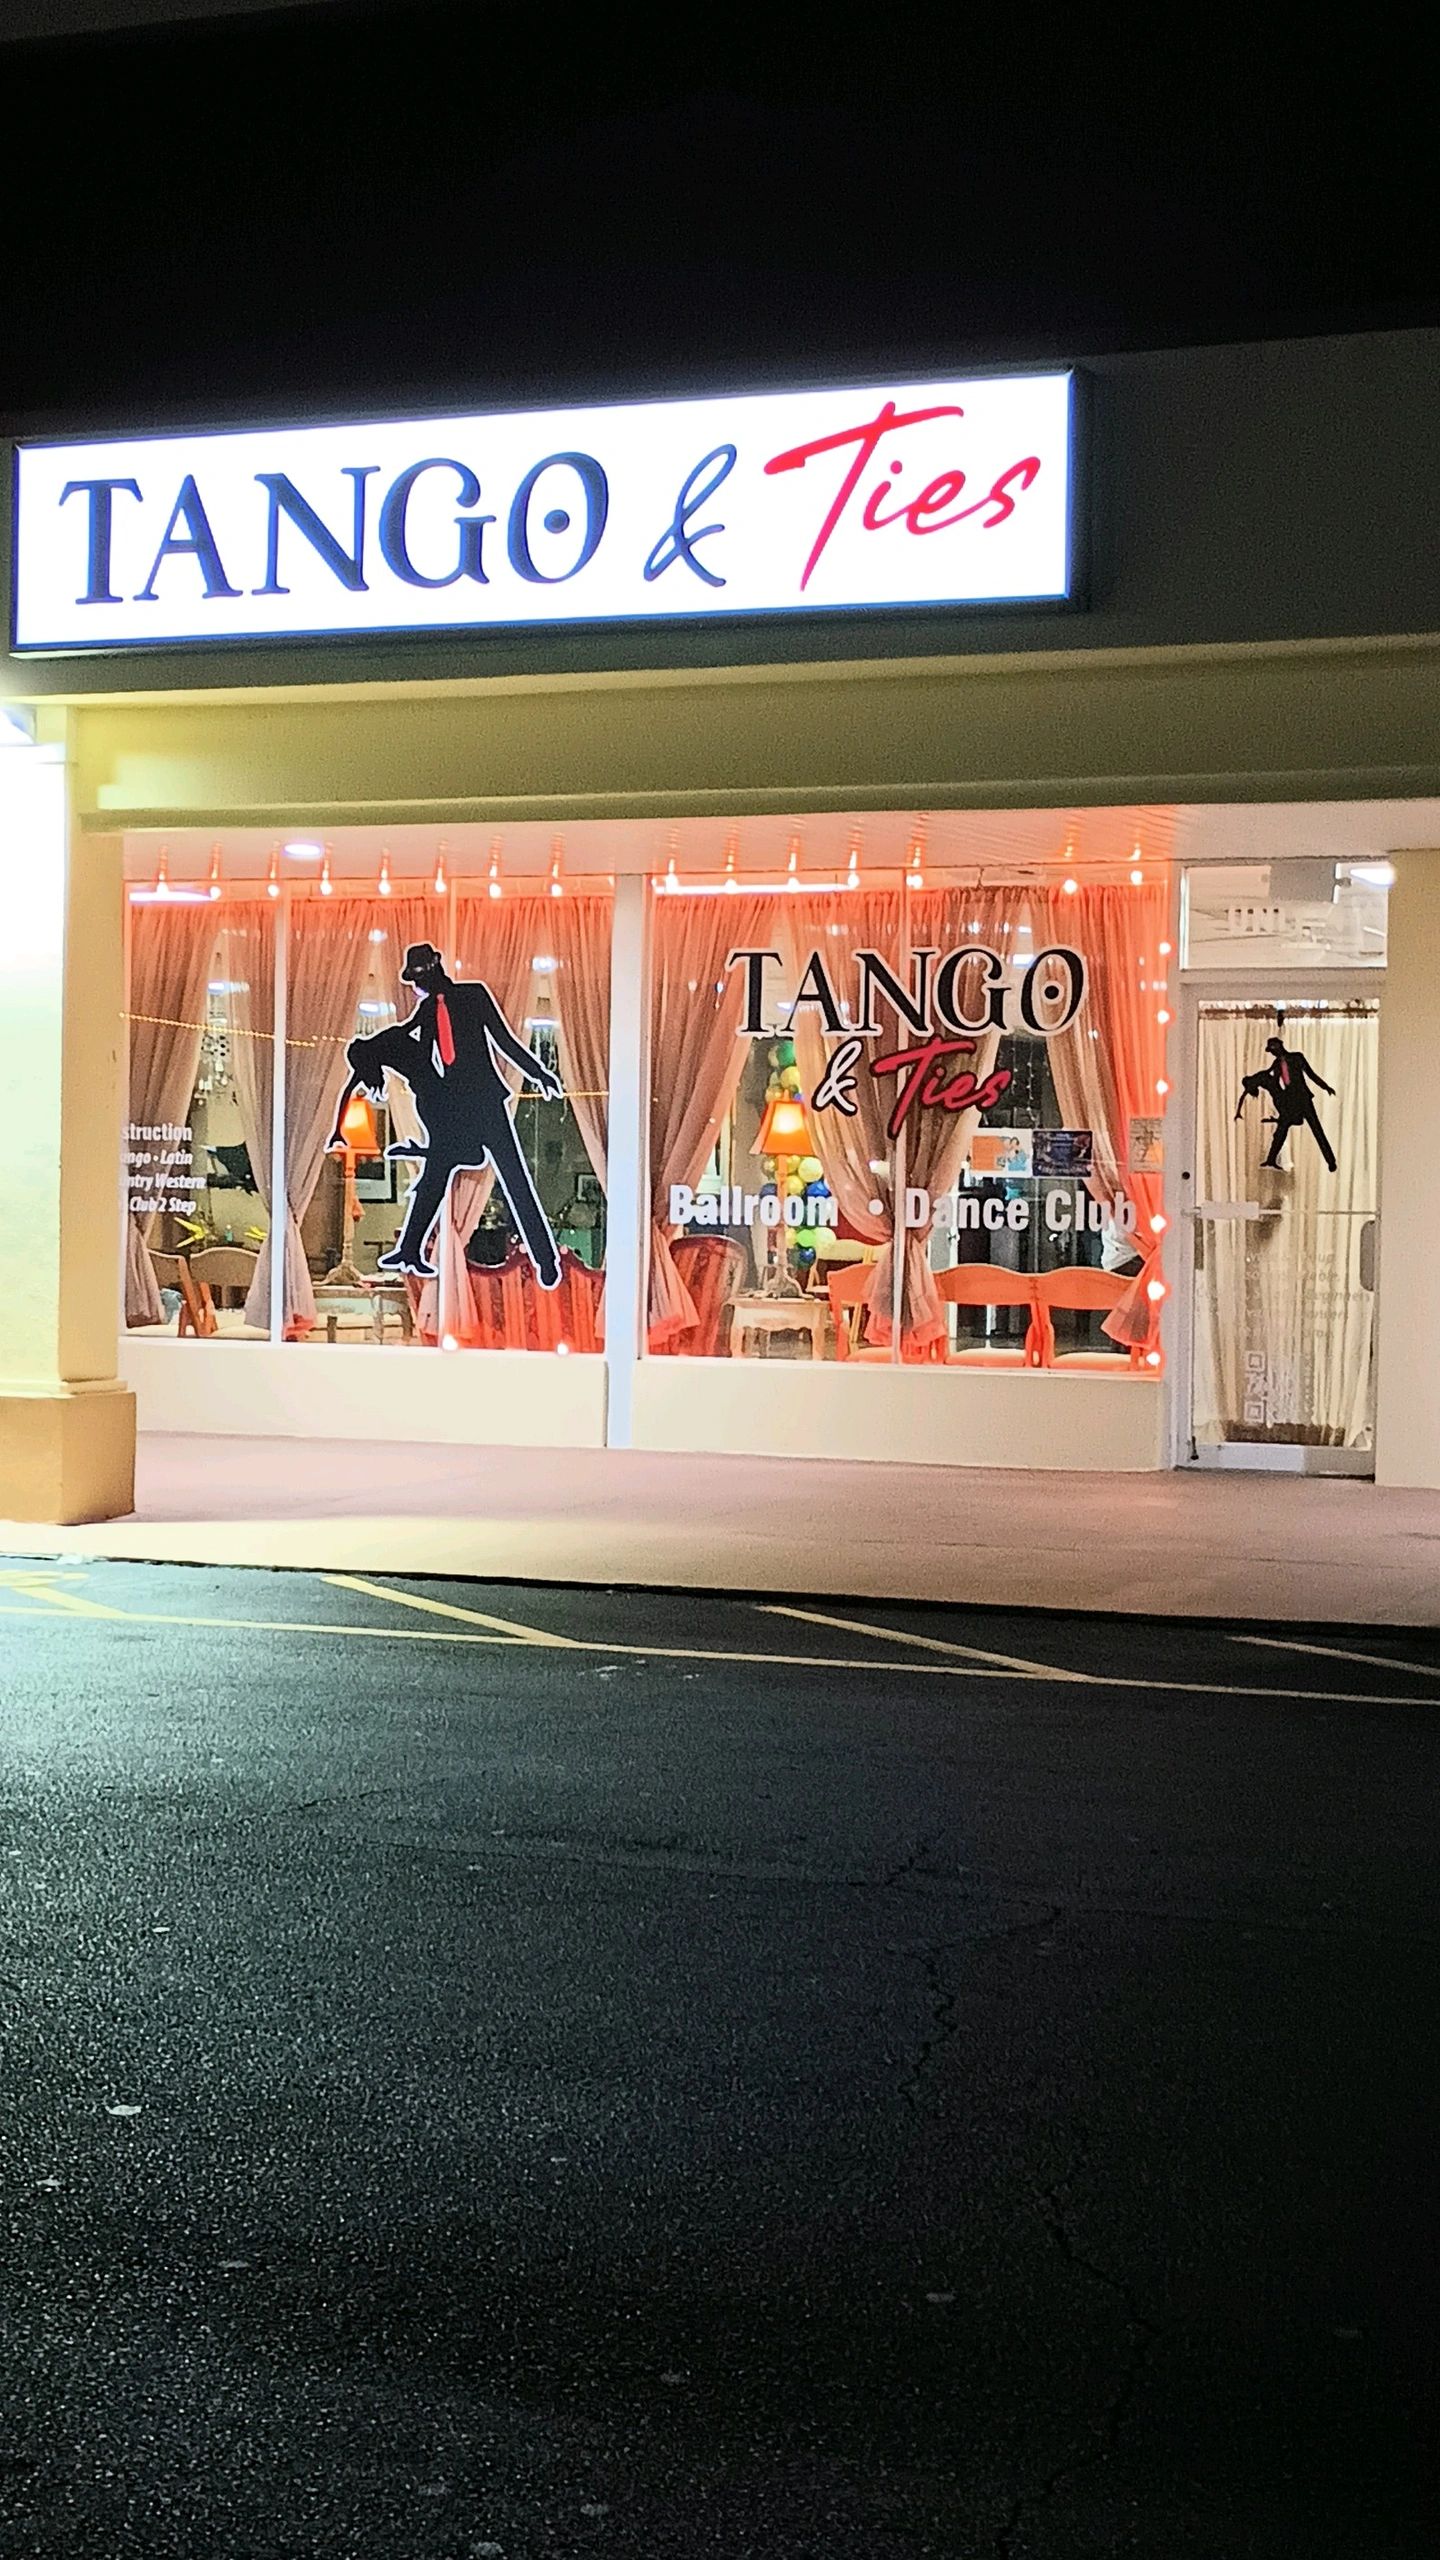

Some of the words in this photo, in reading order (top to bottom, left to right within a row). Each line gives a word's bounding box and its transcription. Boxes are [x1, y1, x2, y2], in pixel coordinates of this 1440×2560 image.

[58, 451, 609, 605] TANGO
[643, 443, 738, 588] &
[763, 401, 1042, 593] Ties
[727, 945, 1087, 1036] TANGO
[812, 1040, 863, 1116] &
[871, 1037, 1014, 1139] Ties
[154, 1172, 207, 1189] Western
[160, 1149, 193, 1165] Latin
[130, 1196, 157, 1212] Club
[157, 1197, 167, 1212] 2
[168, 1197, 196, 1216] Step
[669, 1184, 839, 1228] Ballroom
[905, 1188, 1030, 1232] Dance
[1044, 1188, 1137, 1234] Club
